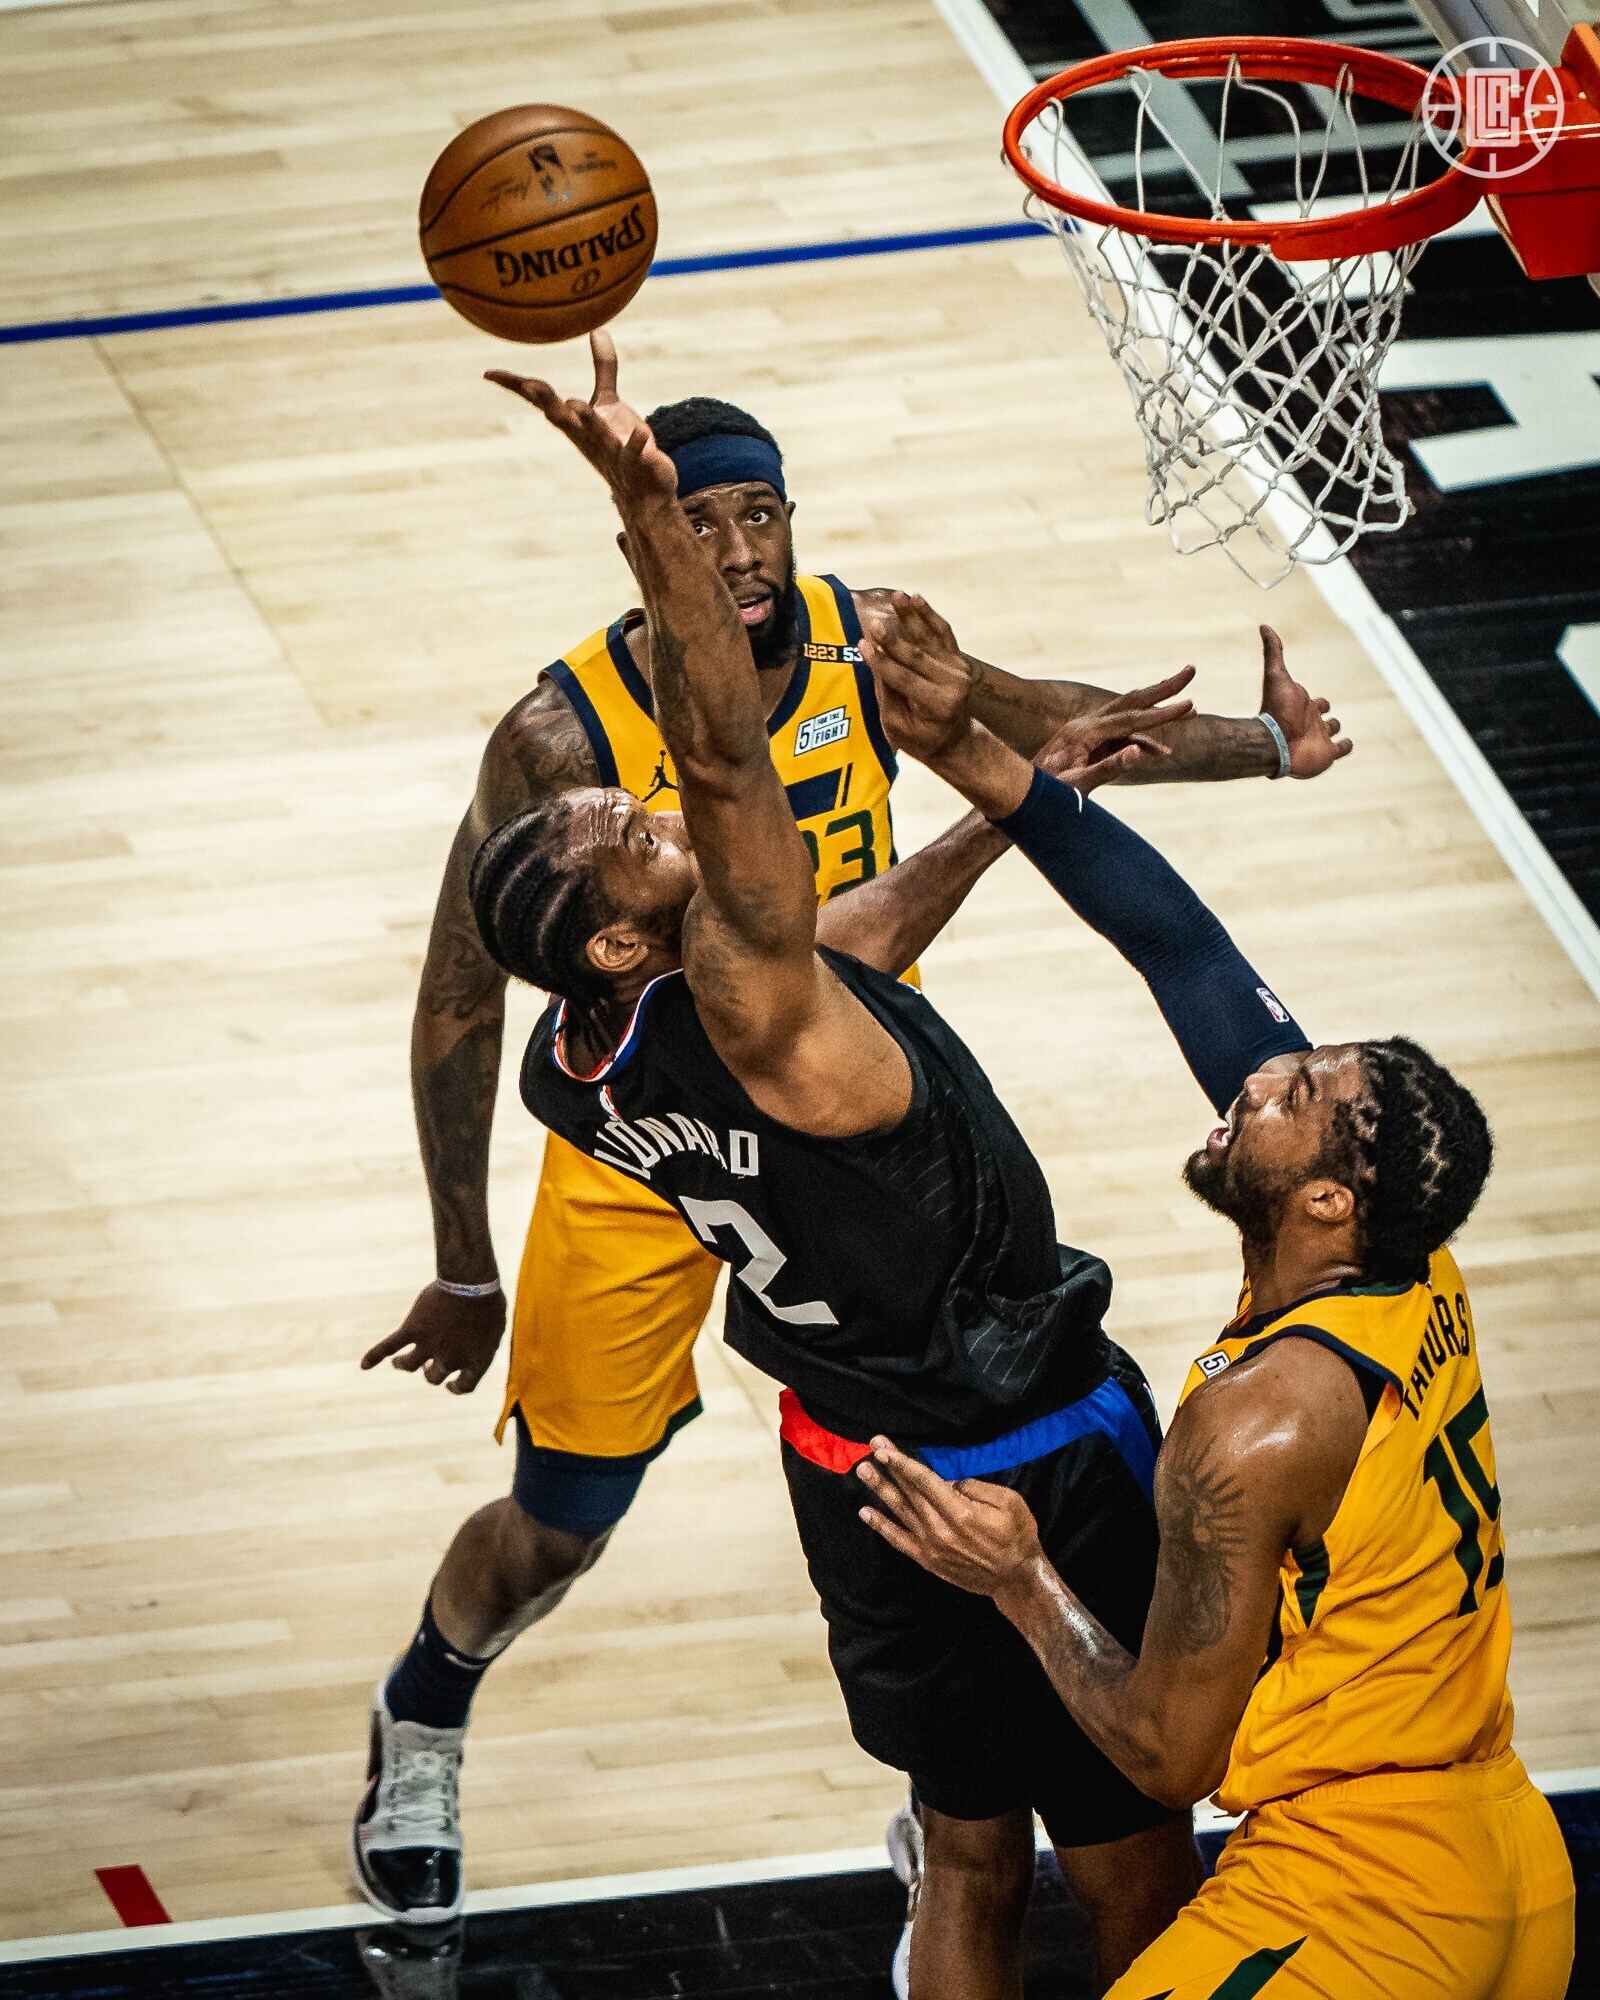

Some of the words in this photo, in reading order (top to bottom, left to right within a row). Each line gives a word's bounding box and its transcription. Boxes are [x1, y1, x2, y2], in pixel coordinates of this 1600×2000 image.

[493, 204, 647, 287] SPALDING
[804, 643, 838, 660] 1223
[843, 646, 863, 662] 53
[799, 722, 811, 750] 5
[815, 723, 846, 744] FIGHT
[593, 1112, 760, 1181] LONARD
[679, 1196, 839, 1325] 2
[1203, 1355, 1227, 1370] 5
[1423, 1386, 1505, 1619] 15
